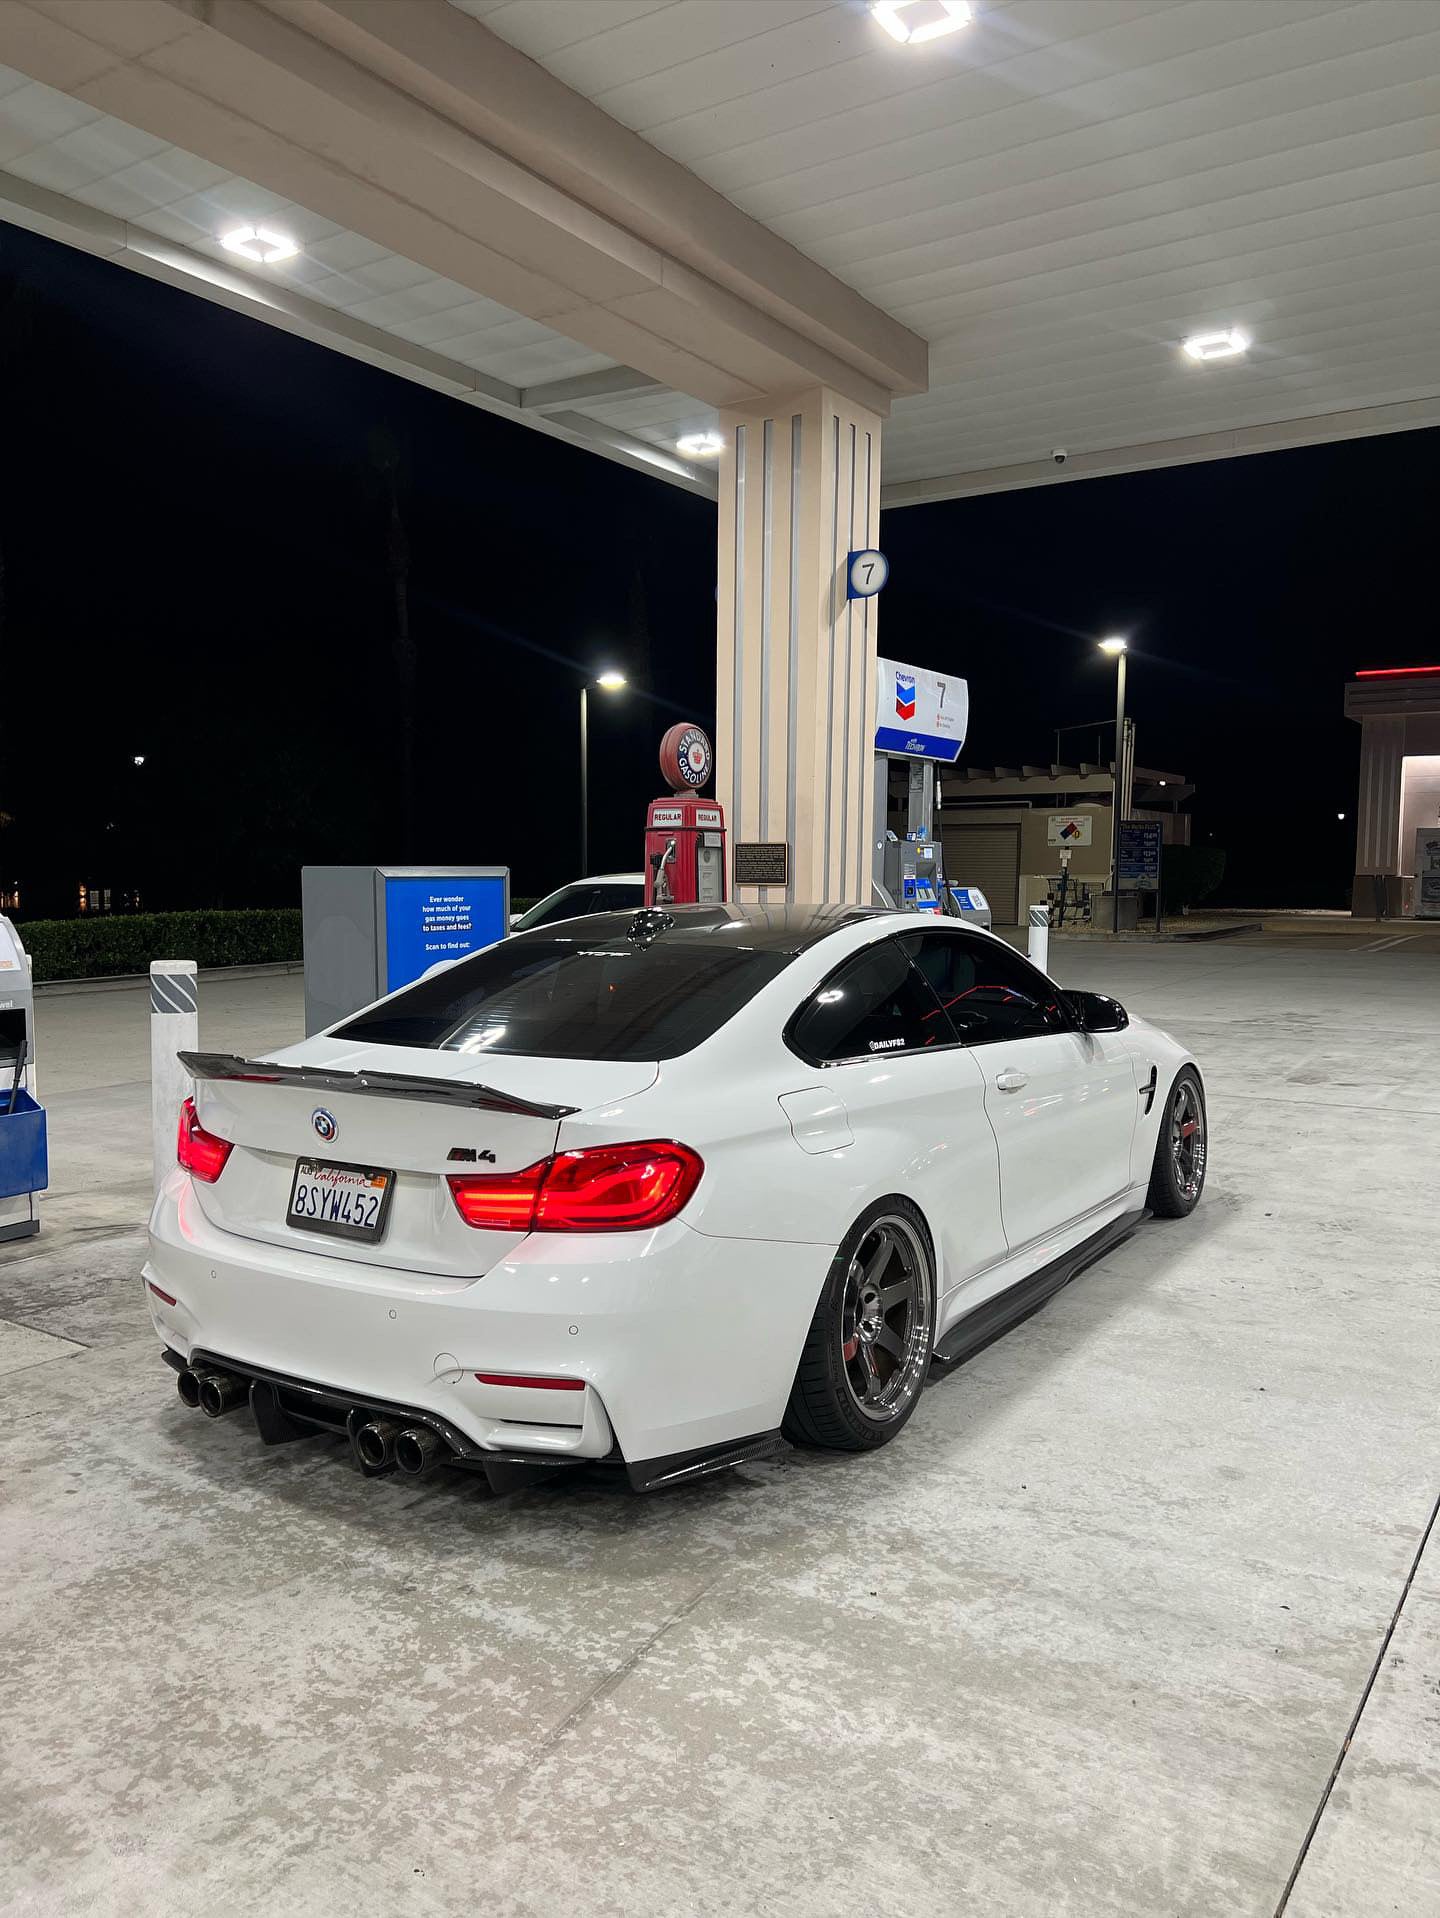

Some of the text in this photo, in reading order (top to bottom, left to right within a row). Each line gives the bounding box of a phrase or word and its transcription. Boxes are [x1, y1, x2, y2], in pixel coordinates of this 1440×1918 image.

[862, 563, 875, 585] 7
[895, 671, 915, 684] Chevron
[936, 681, 946, 709] 7
[679, 730, 711, 761] STANDARD
[679, 758, 709, 784] GASOLINE
[654, 813, 682, 821] REGULAR
[698, 814, 717, 822] REGULAR
[456, 914, 469, 922] goes
[425, 943, 440, 951] Scan
[313, 1168, 372, 1188] California
[294, 1184, 379, 1228] 8SYW452
